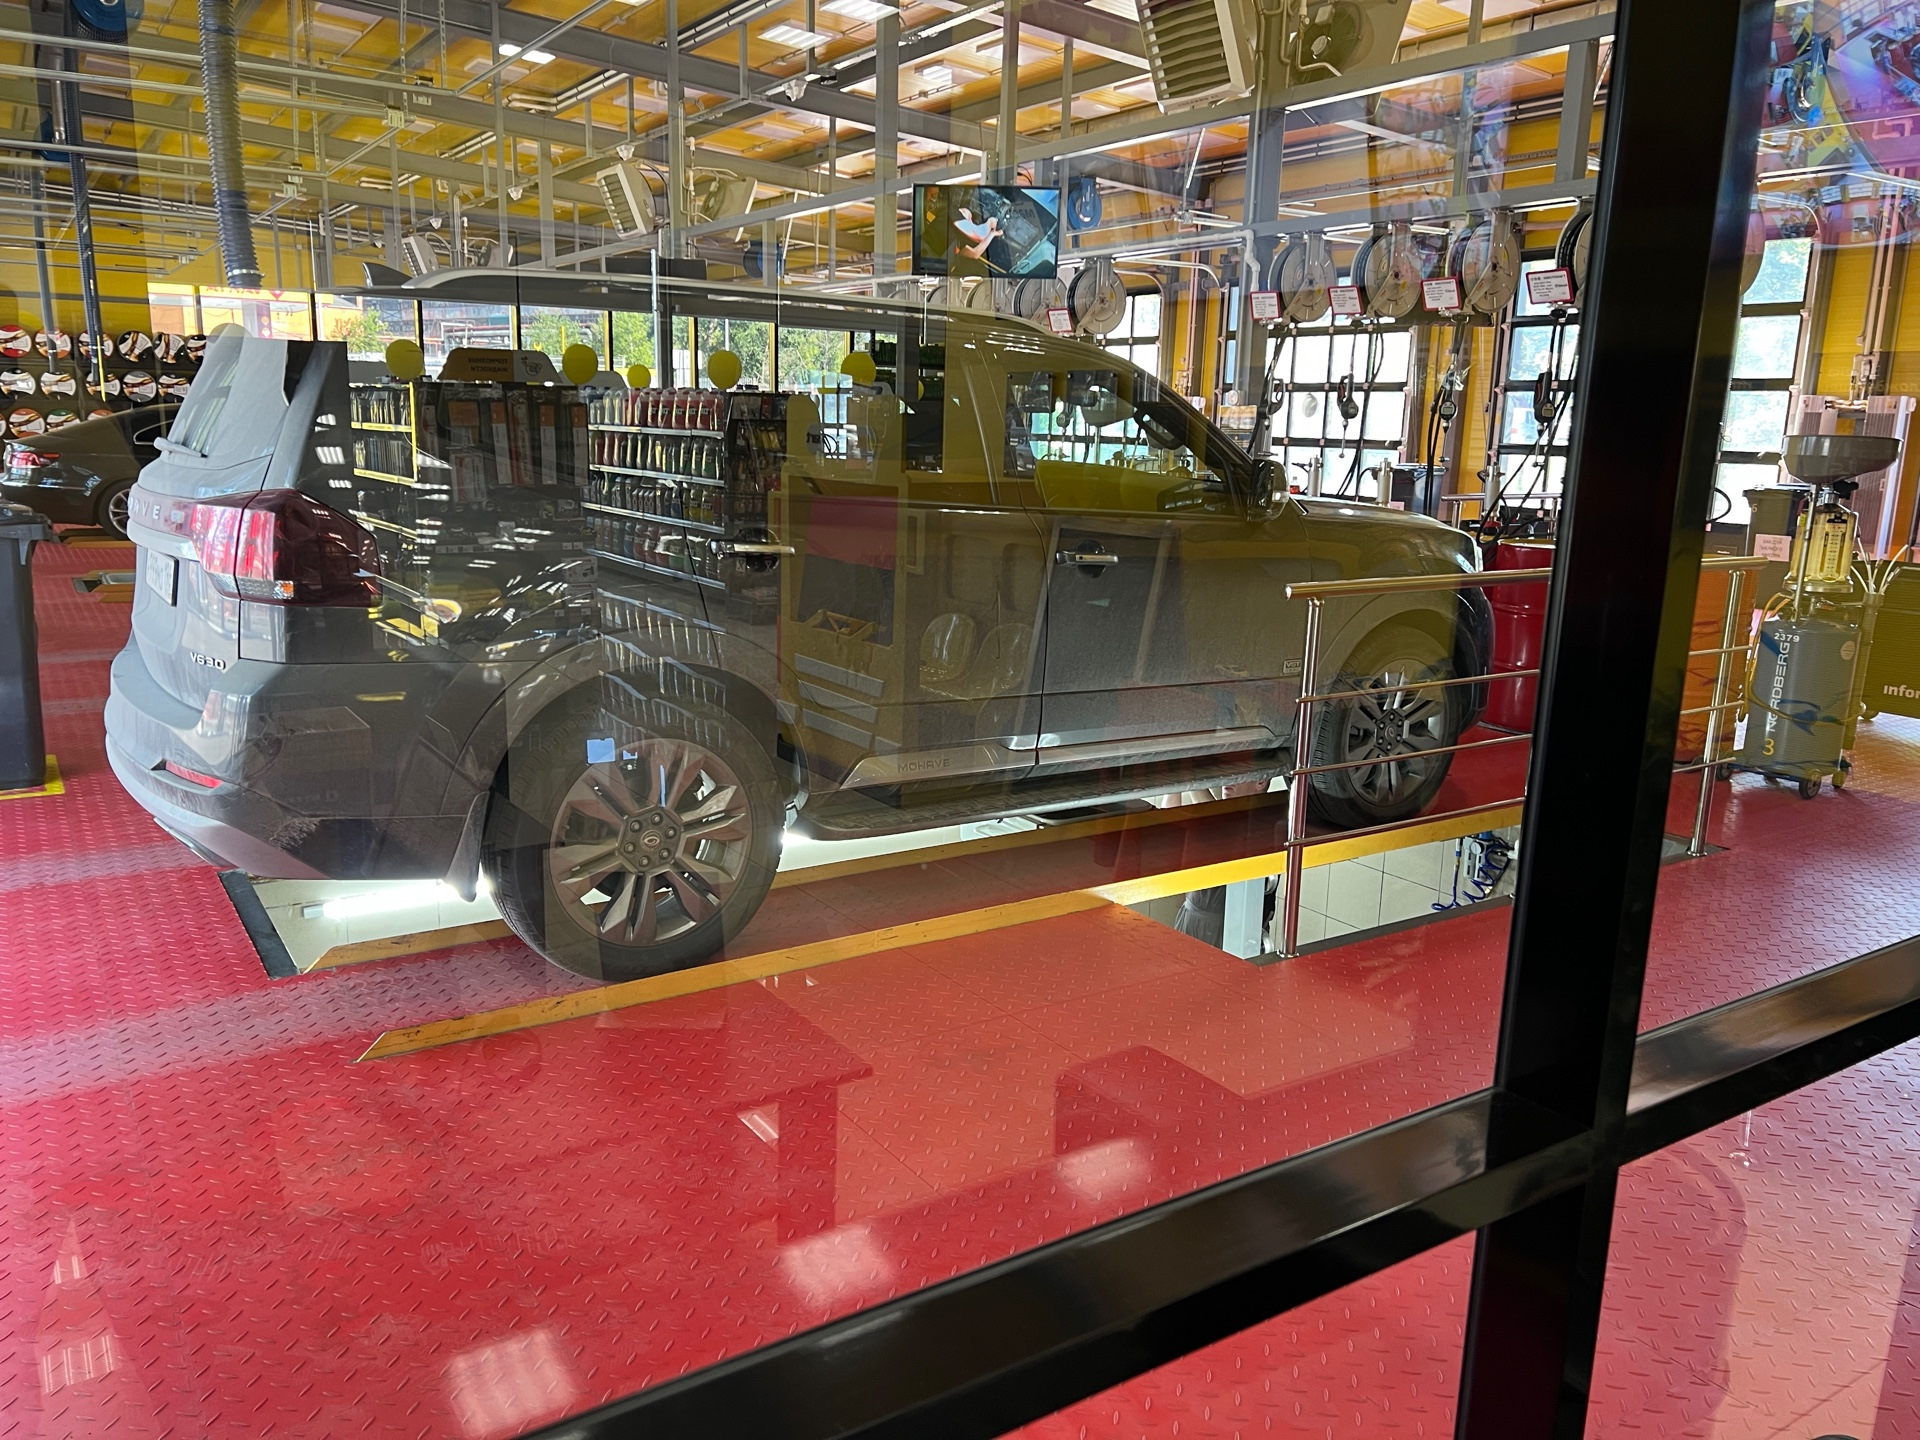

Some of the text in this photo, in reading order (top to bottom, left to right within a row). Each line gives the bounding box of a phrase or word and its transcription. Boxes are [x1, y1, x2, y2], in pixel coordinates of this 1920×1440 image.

[1773, 632, 1800, 643] 2379
[1766, 641, 1791, 733] NORDBERG
[1762, 738, 1775, 756] 3
[898, 758, 950, 772] MOHAVE
